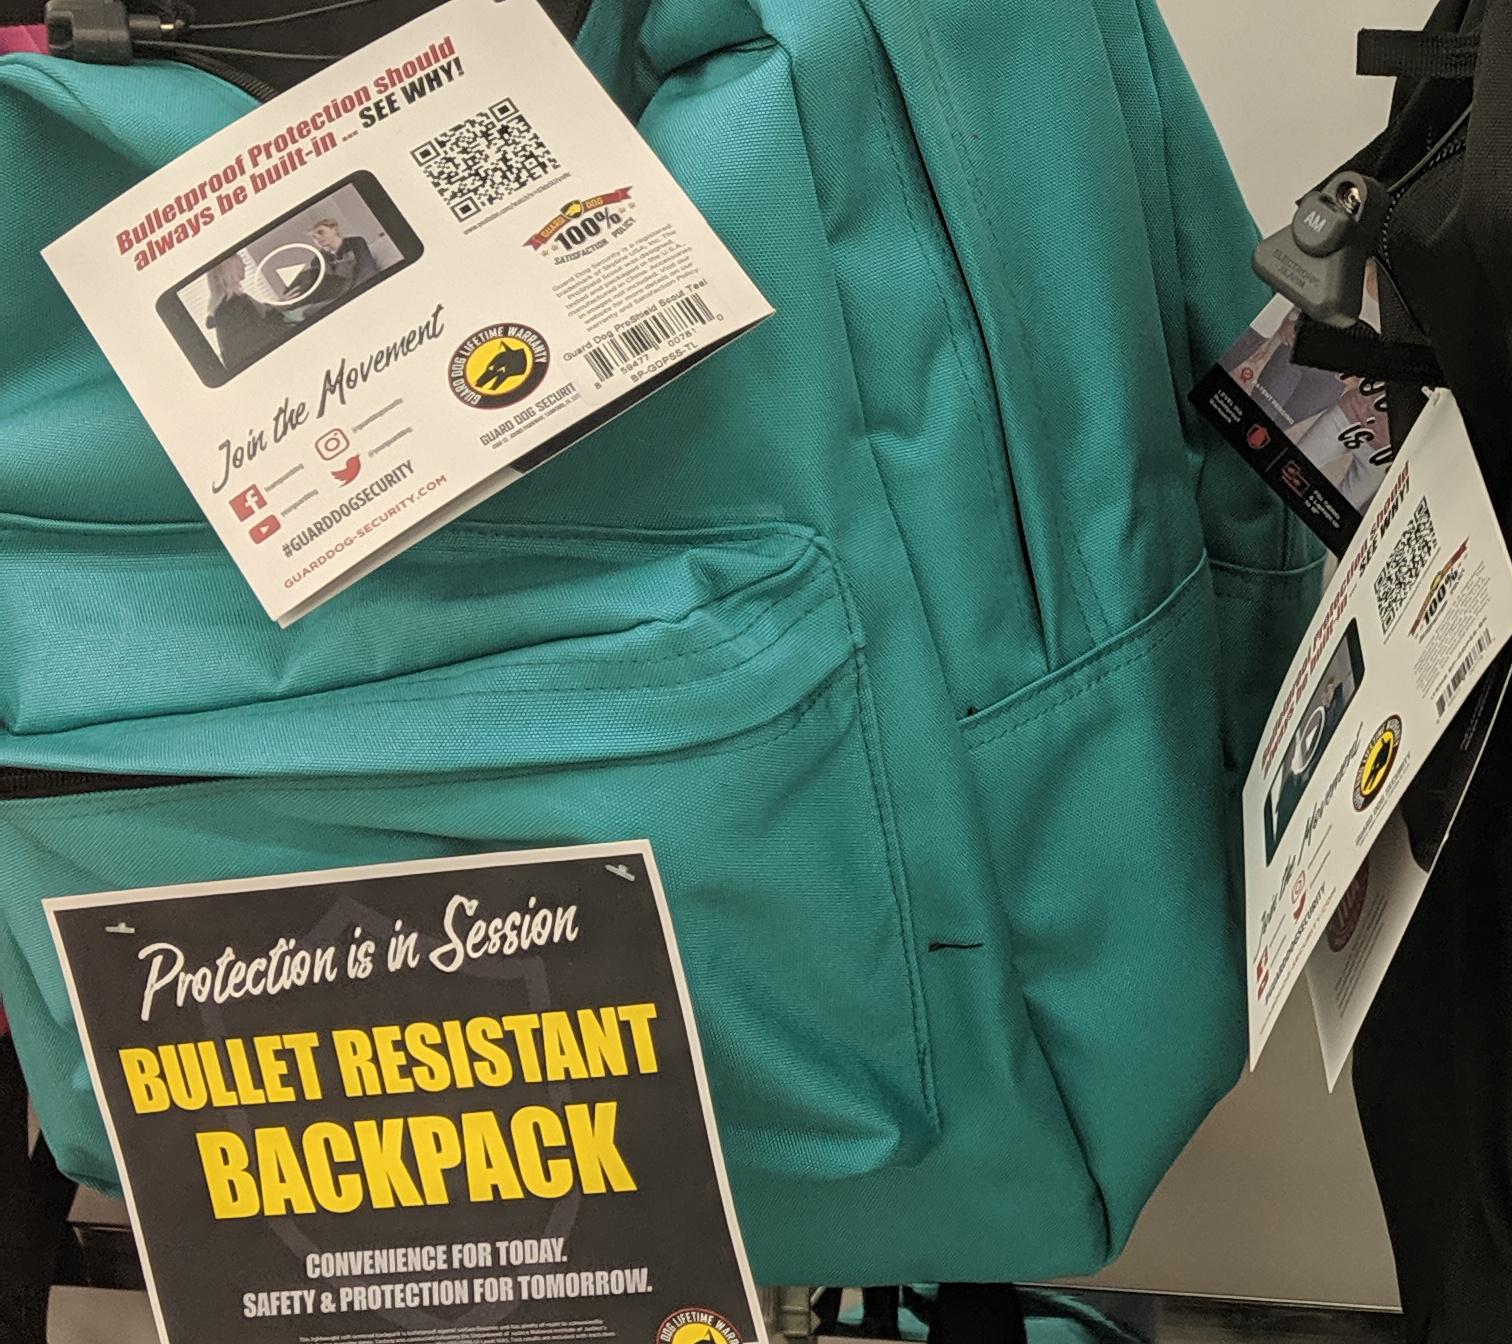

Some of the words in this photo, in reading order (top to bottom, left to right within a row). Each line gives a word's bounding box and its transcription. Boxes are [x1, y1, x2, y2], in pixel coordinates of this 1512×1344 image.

[115, 154, 248, 256] Bulletproof
[248, 85, 372, 169] Protection
[373, 36, 456, 94] should
[134, 208, 215, 272] always
[216, 186, 248, 217] be
[250, 131, 338, 195] built-in
[358, 96, 400, 129] SEE
[400, 57, 465, 106] WHY!
[554, 208, 622, 251] 100%
[554, 238, 609, 265] SATISFACTION
[611, 217, 636, 238] POLICY
[460, 326, 504, 356] LIFETIME
[508, 326, 547, 363] WARRANTY
[563, 342, 592, 361] Guard
[594, 331, 614, 345] Dog
[614, 305, 658, 331] ProShield
[658, 290, 685, 307] Scout
[687, 278, 707, 292] Teal
[212, 428, 268, 494] Join
[273, 397, 309, 443] the
[317, 304, 444, 419] Movement
[451, 357, 466, 377] DOG
[453, 379, 481, 405] GUARD
[480, 422, 514, 446] GUARD
[514, 407, 536, 424] DOG
[536, 382, 577, 411] SECURIT
[282, 460, 414, 557] #GUARDDOGSECURITY
[284, 475, 447, 588] GUARDDOG-SECURITY.COM
[138, 937, 337, 1022] Protection
[347, 926, 373, 980] is
[388, 919, 420, 972] in
[429, 895, 579, 973] Session
[119, 1031, 322, 1115] BULLET
[332, 1003, 659, 1096] RESISTANT
[196, 1101, 637, 1220] BACKPACK
[306, 1245, 448, 1279] CONVENIENCE
[452, 1243, 492, 1268] FOR
[496, 1237, 568, 1265] TODAY.
[243, 1290, 315, 1318] SAFETY
[320, 1293, 336, 1313] &
[339, 1281, 469, 1312] PROTECTION
[473, 1277, 514, 1303] FOR
[517, 1268, 653, 1300] TOMORROW.
[661, 1324, 676, 1342] DOG
[673, 1311, 714, 1328] LIFETIME
